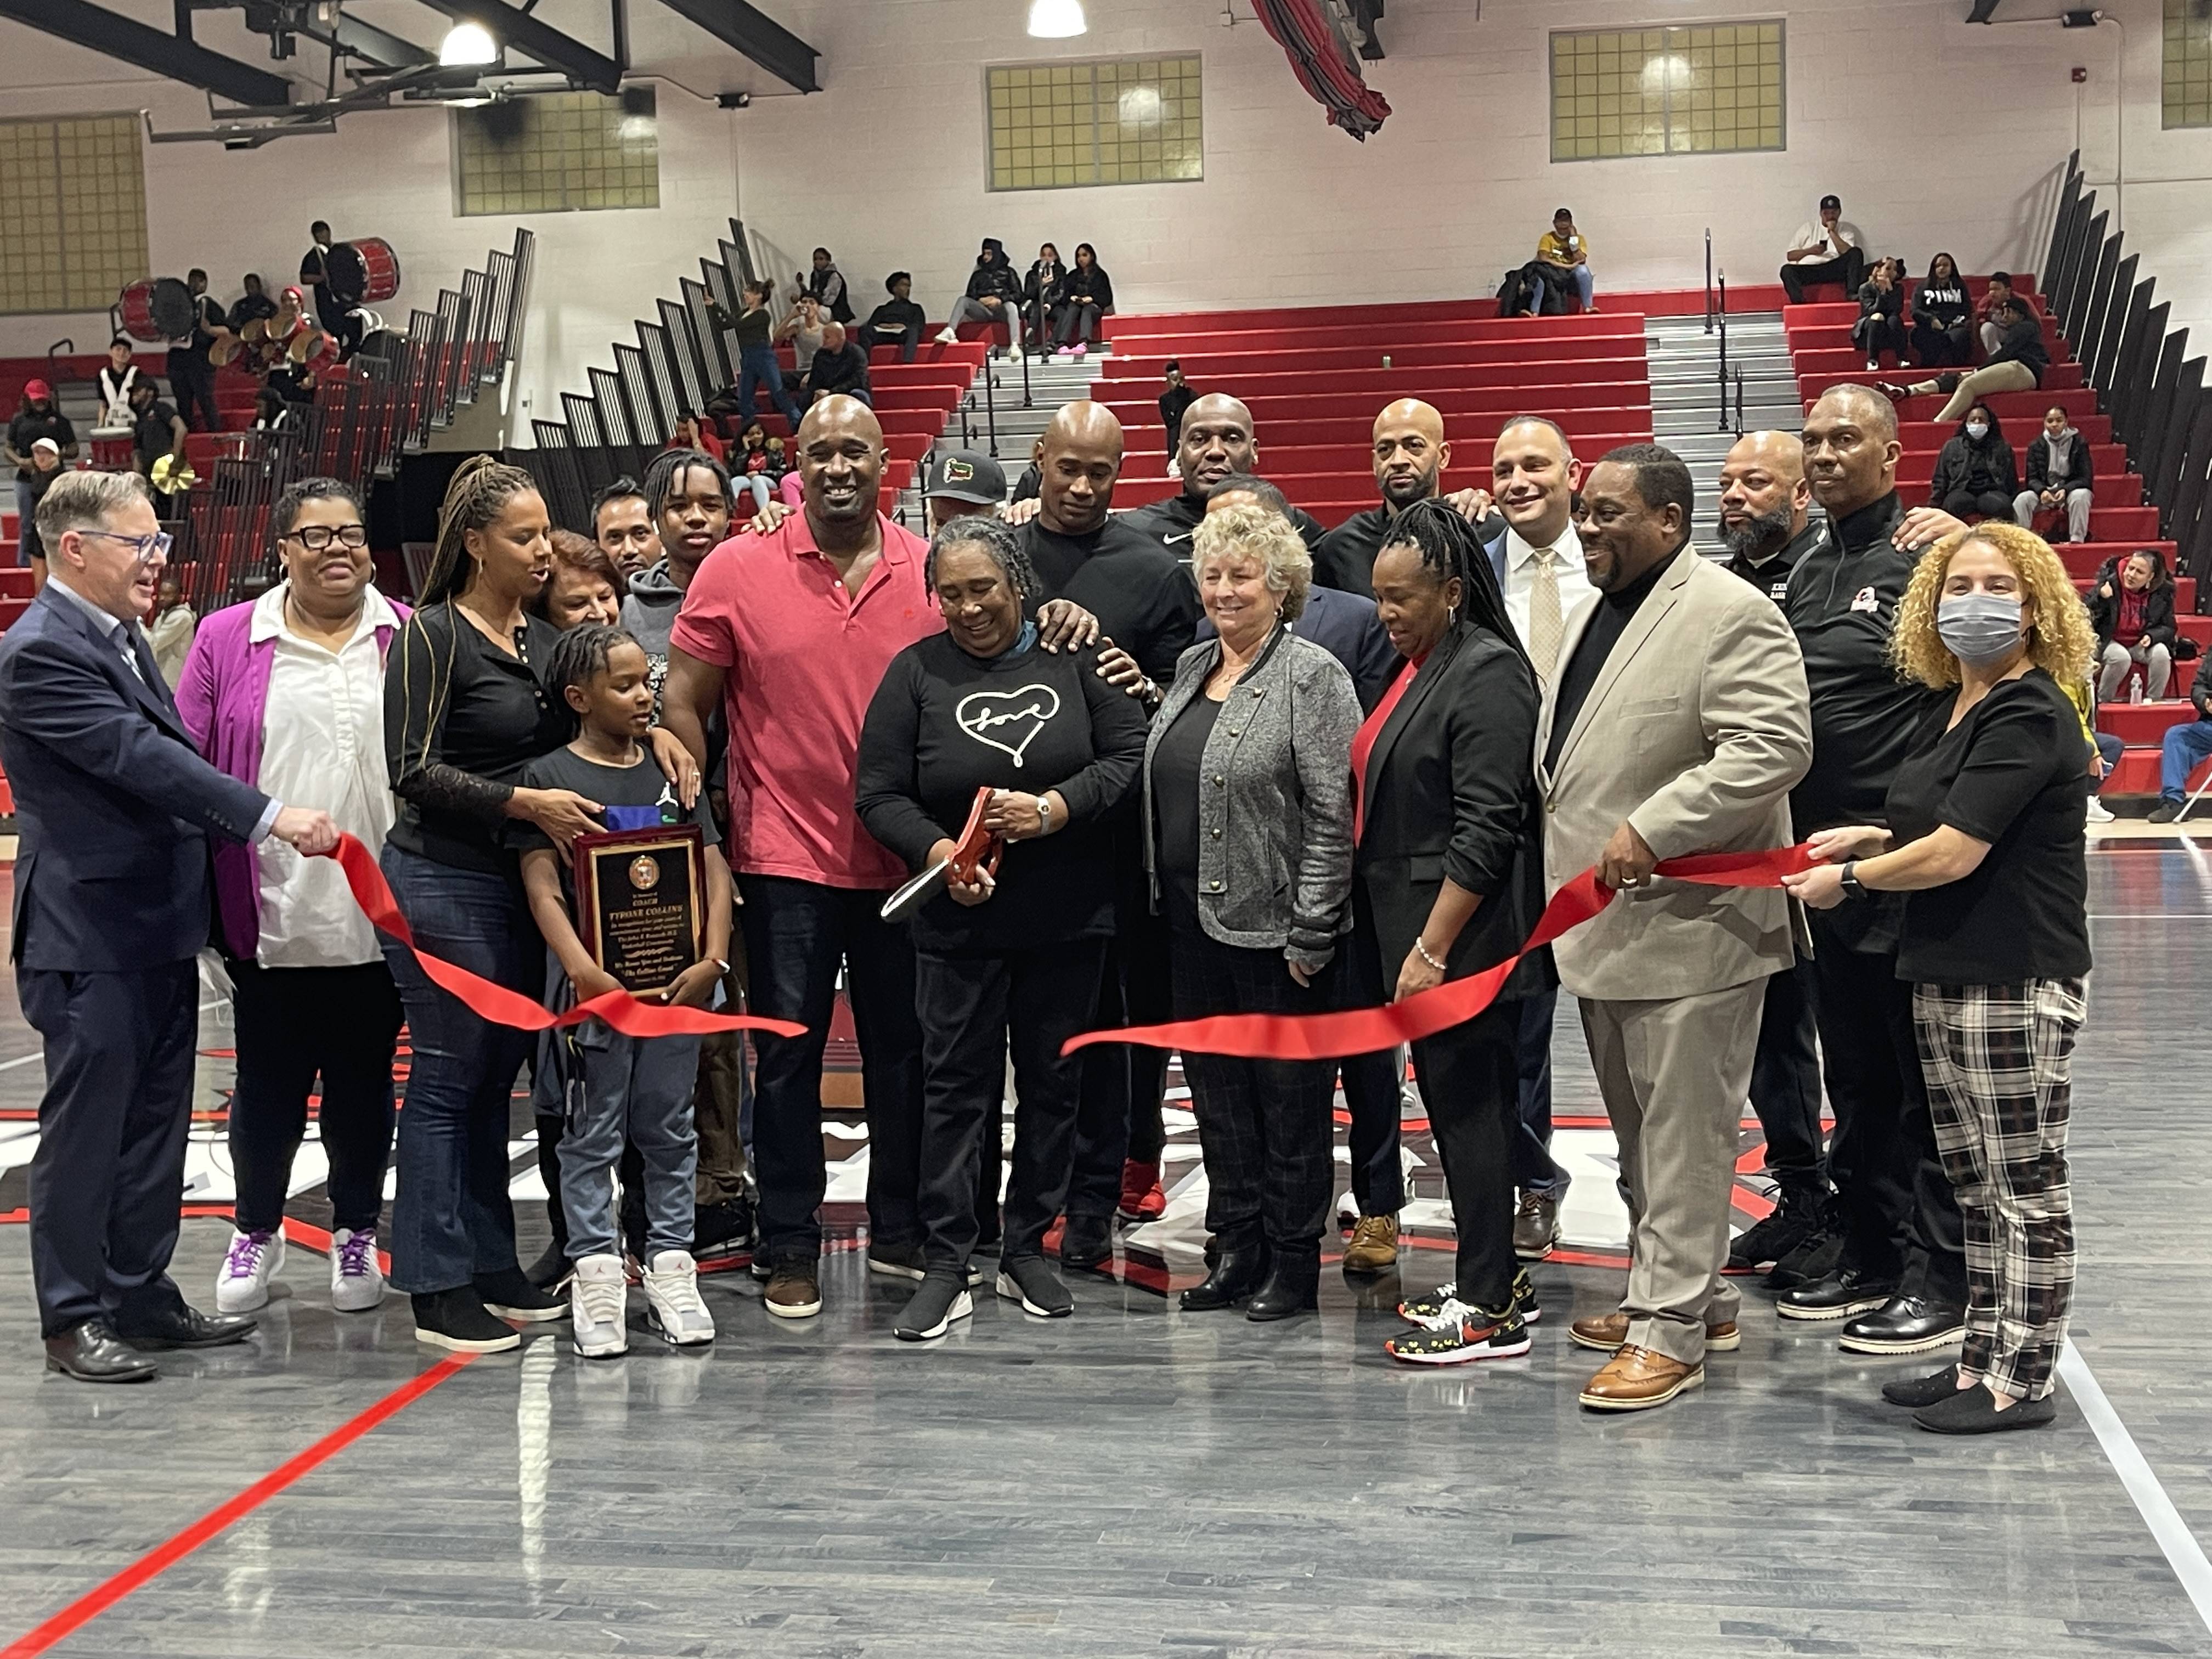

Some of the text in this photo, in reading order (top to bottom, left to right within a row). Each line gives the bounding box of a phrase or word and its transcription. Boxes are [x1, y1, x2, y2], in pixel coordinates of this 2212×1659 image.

[633, 898, 658, 907] COACH
[609, 905, 683, 920] TYRONE COLLINS
